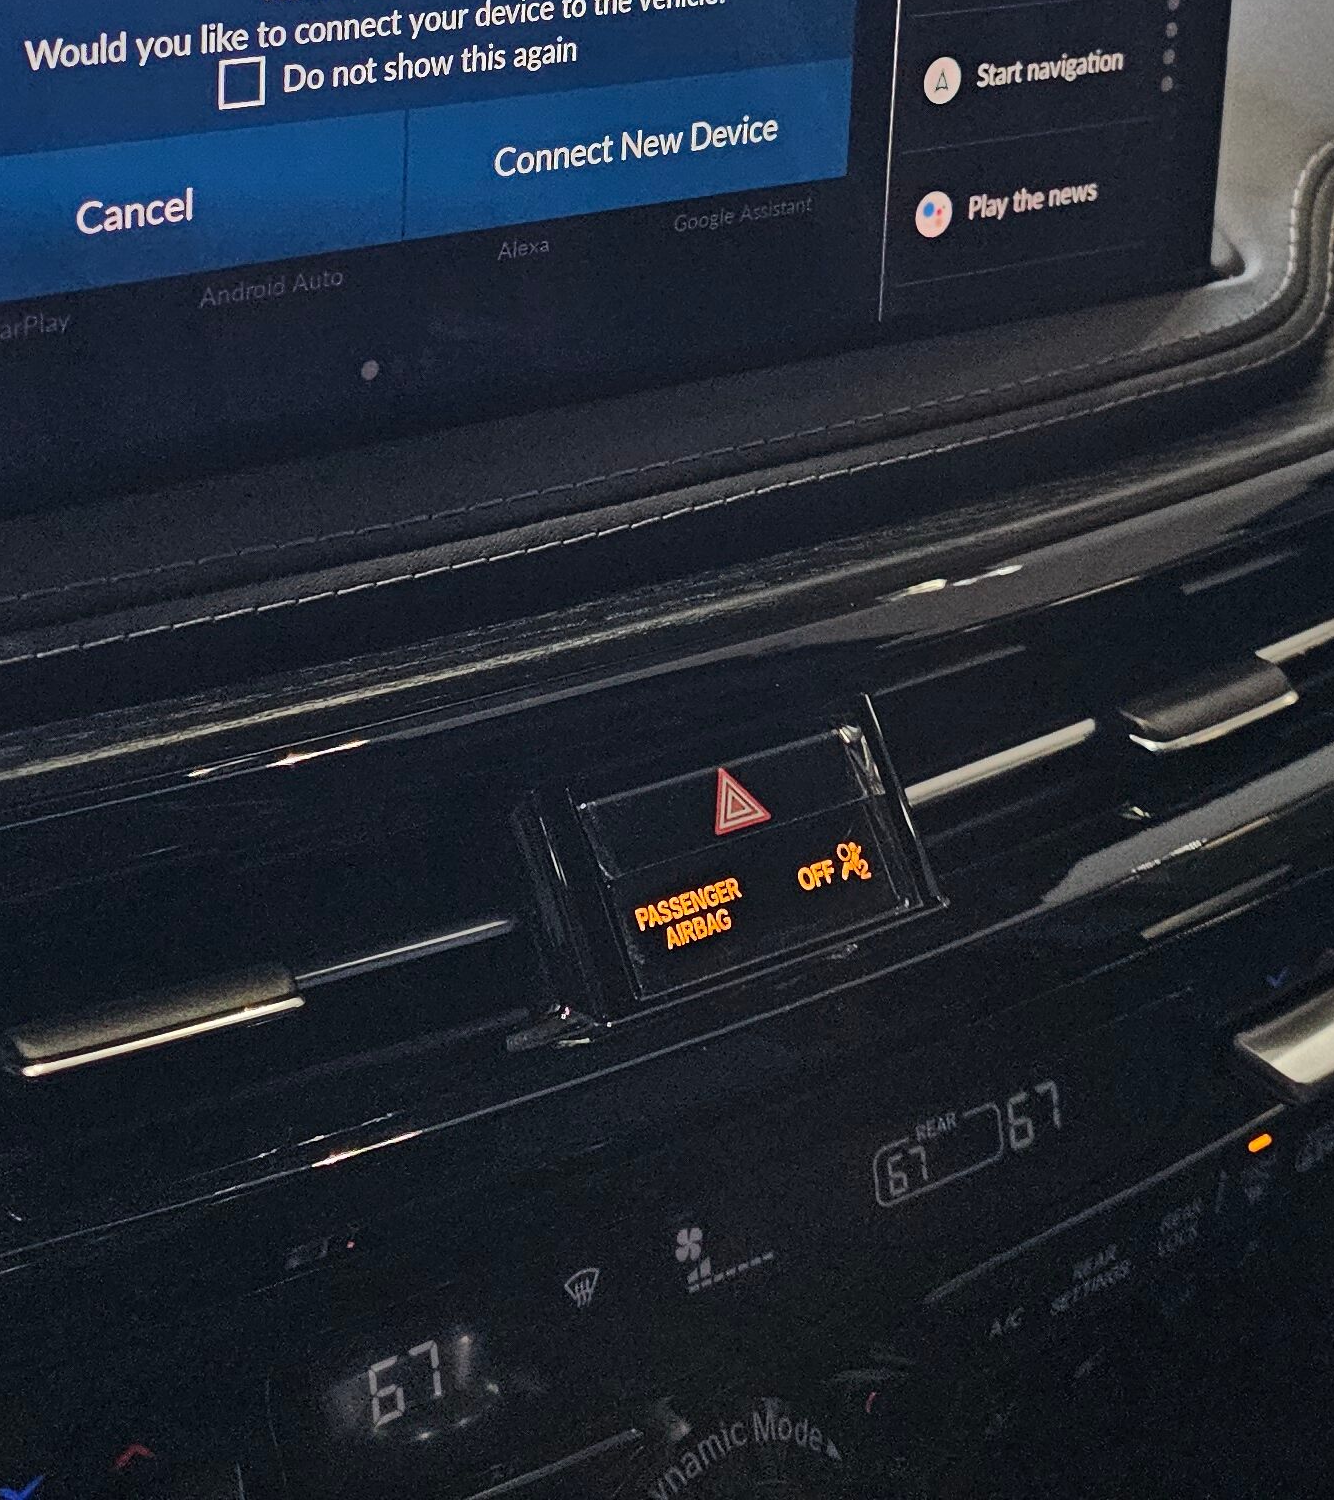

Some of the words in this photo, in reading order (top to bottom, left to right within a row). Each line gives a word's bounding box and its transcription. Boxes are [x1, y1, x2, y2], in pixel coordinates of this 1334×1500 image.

[25, 31, 127, 71] Would
[136, 35, 192, 67] you
[200, 22, 249, 55] like
[257, 21, 287, 48] to
[294, 10, 402, 44] connect
[408, 8, 468, 41] your
[283, 64, 324, 93] Do
[332, 59, 377, 89] not
[383, 49, 453, 83] show
[461, 44, 506, 75] this
[513, 37, 578, 72] again
[977, 62, 1022, 89] Start
[1025, 49, 1124, 83] navigation
[493, 135, 614, 177] Connect
[620, 129, 684, 162] New
[690, 115, 779, 152] Device
[75, 187, 195, 235] Cancel
[674, 205, 734, 234] Google
[739, 197, 814, 226] Assistant
[968, 195, 1008, 223] Play
[1012, 188, 1044, 212] the
[1047, 181, 1097, 207] news
[497, 237, 550, 260] Alexa
[199, 273, 286, 309] Android
[292, 269, 344, 294] Auto
[797, 859, 834, 891] OFF
[634, 877, 743, 931] PASSENGER
[666, 908, 733, 949] AIRBAG
[914, 1111, 958, 1142] REAR
[1006, 1080, 1062, 1151] 67
[886, 1145, 930, 1197] 67
[367, 1339, 443, 1428] 67
[648, 1421, 748, 1500] ynamic
[752, 1411, 823, 1451] Mode
